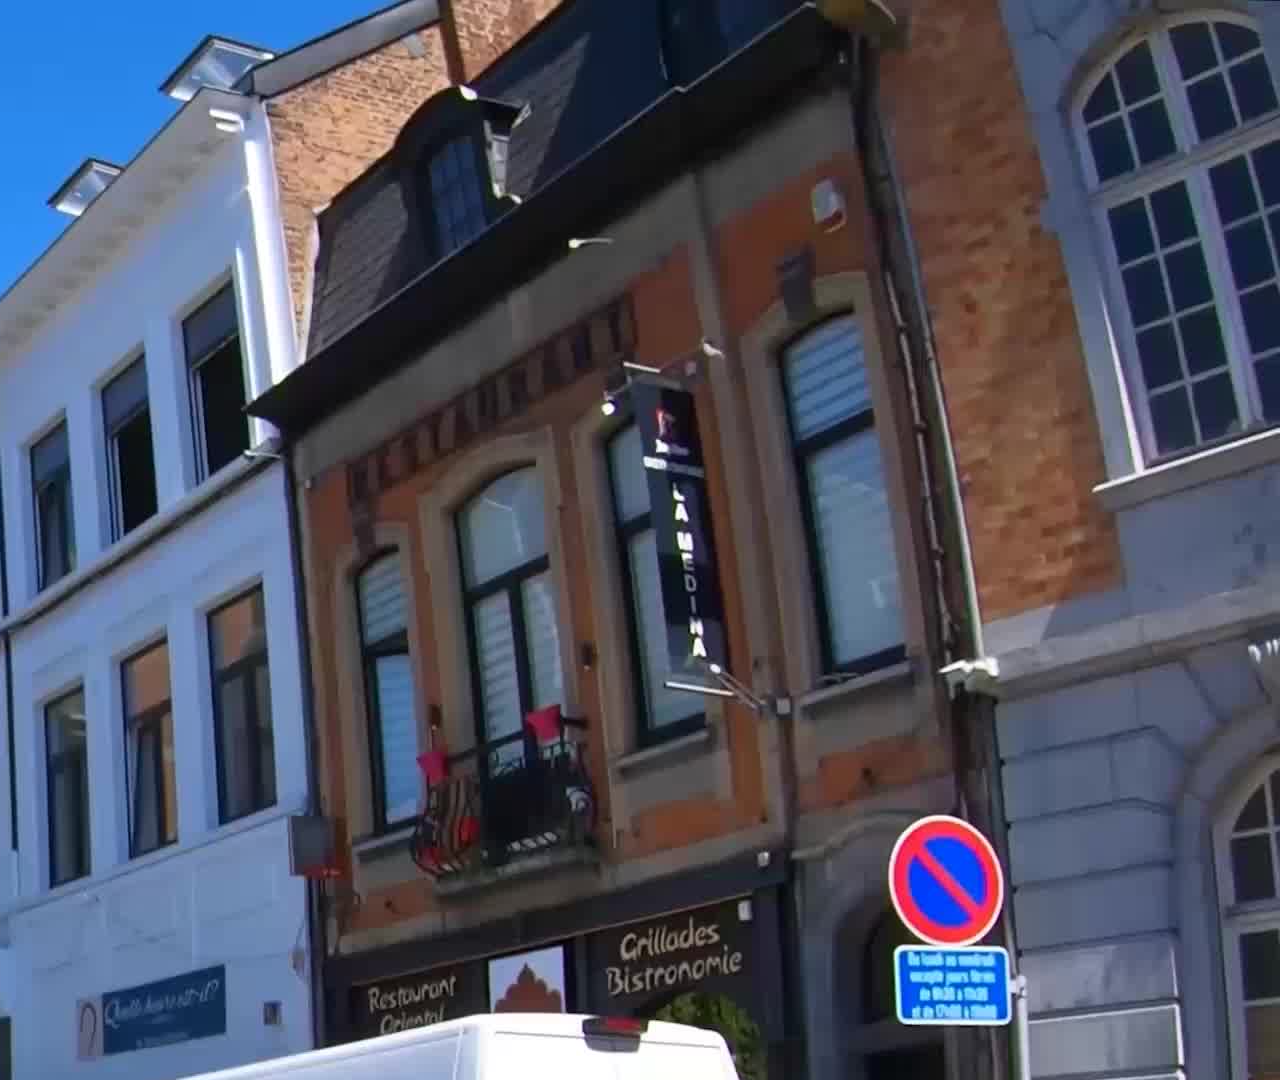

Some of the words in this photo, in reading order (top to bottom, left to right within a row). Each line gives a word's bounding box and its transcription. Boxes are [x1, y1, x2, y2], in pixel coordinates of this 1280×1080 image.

[676, 531, 707, 658] MEDINA
[619, 915, 721, 961] Grillades
[367, 975, 457, 1014] Restaurant
[606, 944, 743, 996] Bistronomie
